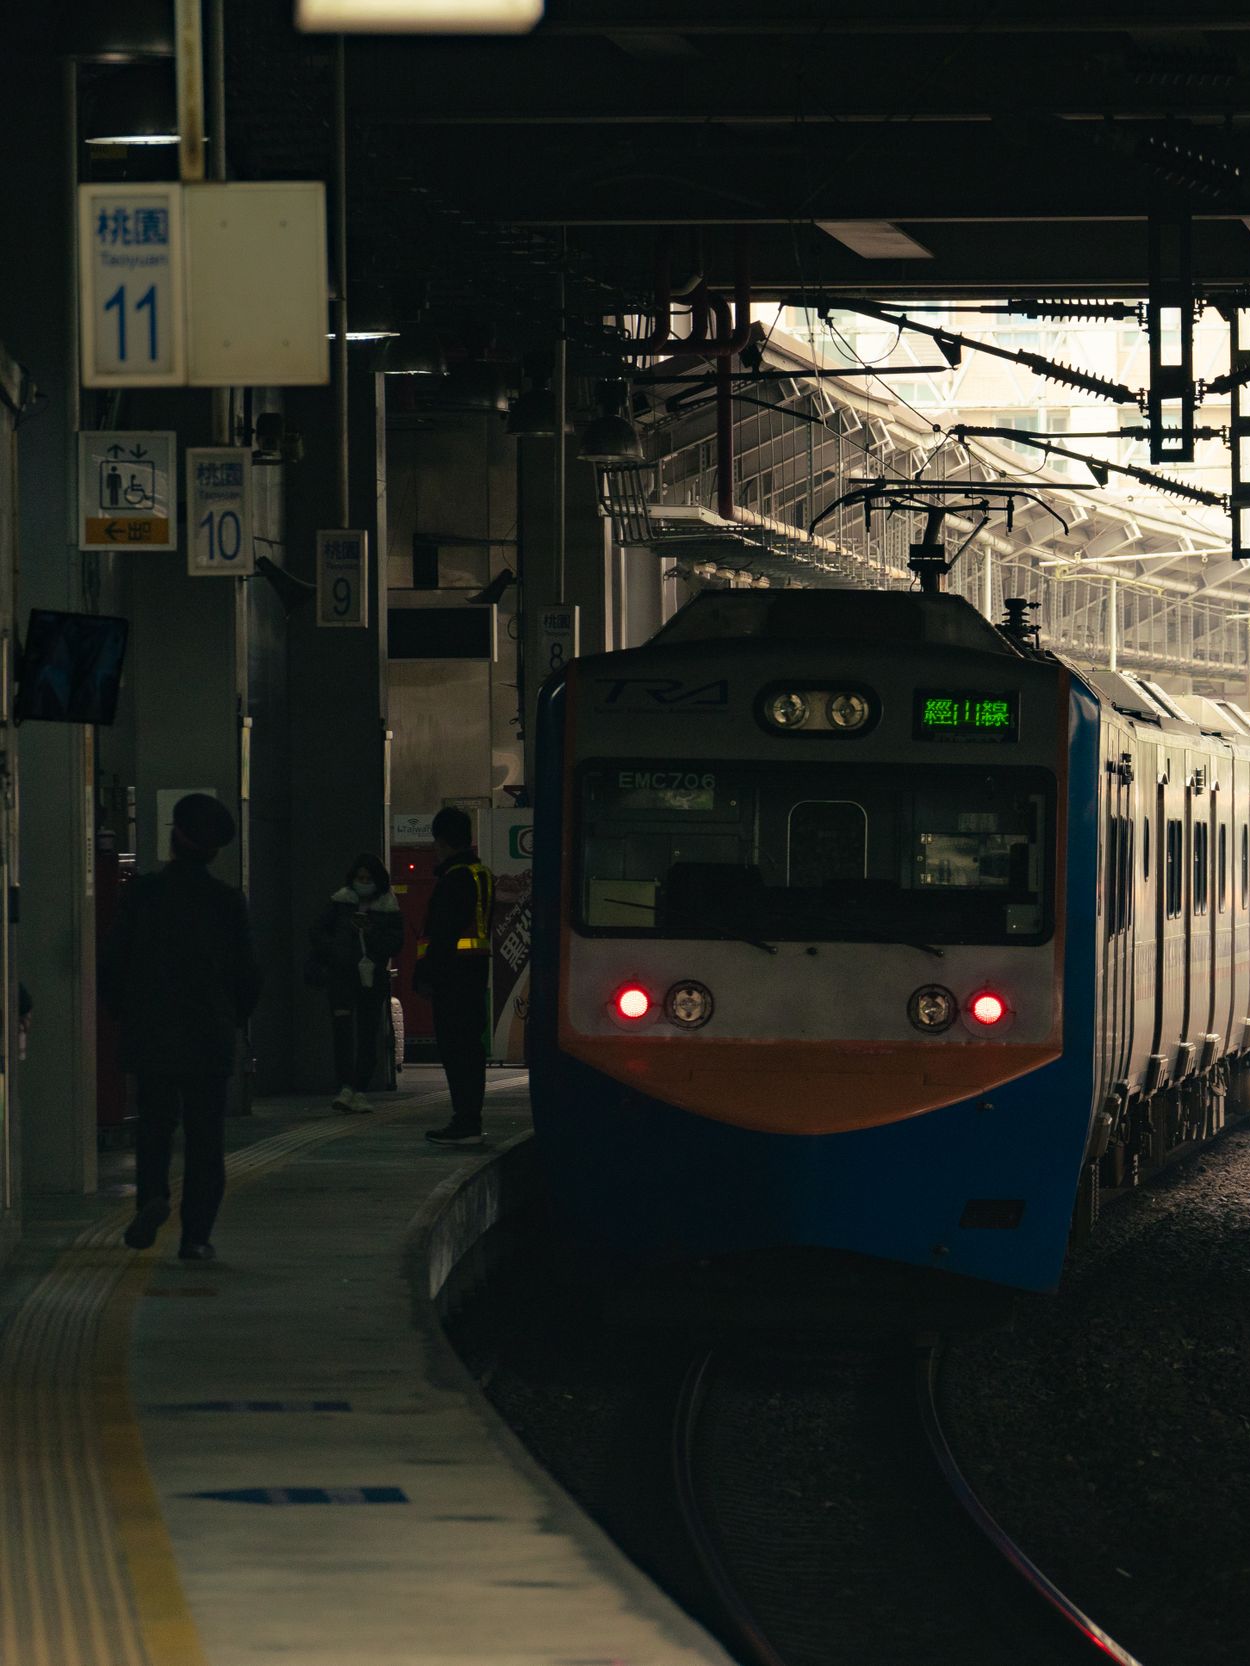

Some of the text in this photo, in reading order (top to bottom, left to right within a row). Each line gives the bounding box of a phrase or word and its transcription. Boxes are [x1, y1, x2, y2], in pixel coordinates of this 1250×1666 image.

[97, 207, 169, 246] 桃園
[104, 284, 156, 361] 11
[197, 463, 243, 487] 桃園
[200, 511, 241, 560] 10
[325, 541, 359, 559] 桃園
[333, 577, 351, 615] 9
[550, 643, 564, 673] 8
[595, 678, 728, 704] TRA
[618, 771, 716, 789] EMC706
